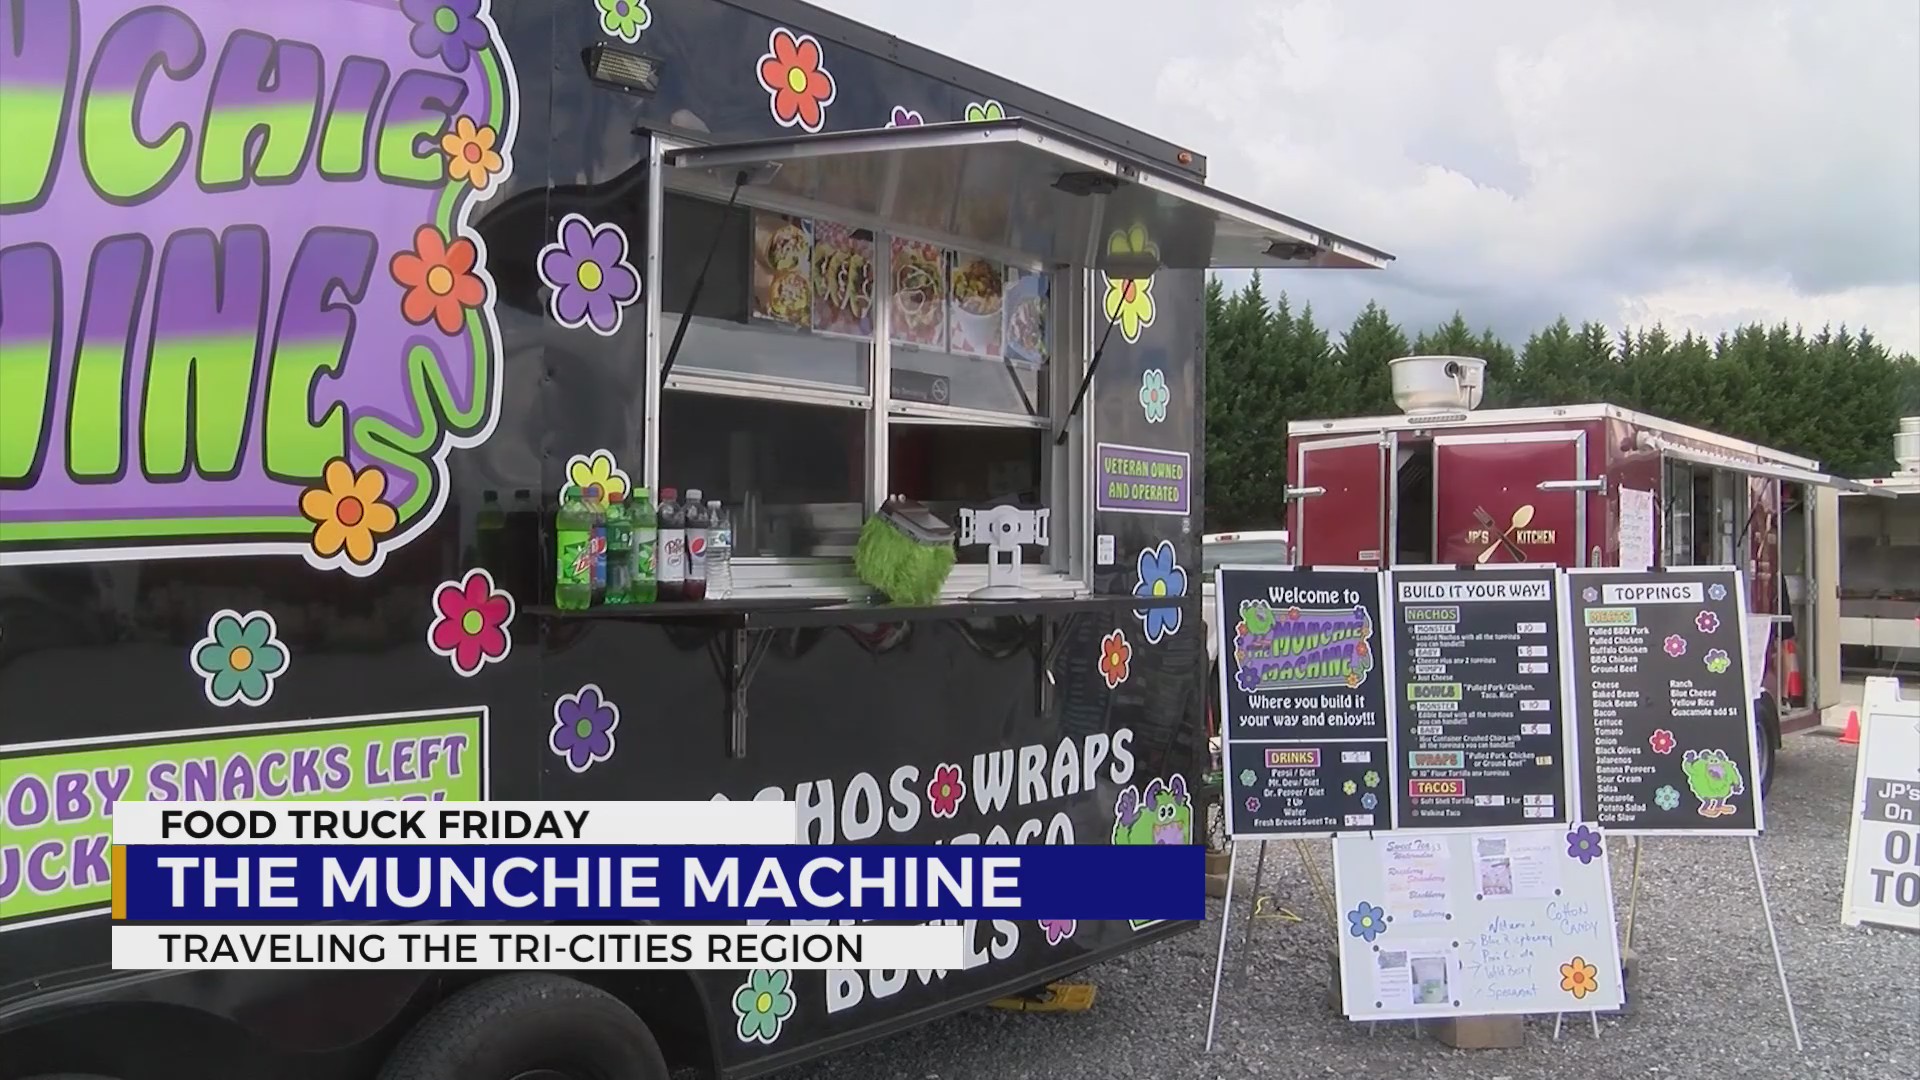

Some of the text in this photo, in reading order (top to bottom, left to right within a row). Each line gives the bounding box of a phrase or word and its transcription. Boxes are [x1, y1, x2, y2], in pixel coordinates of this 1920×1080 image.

[1104, 457, 1184, 480] VETERAN OWNED
[1108, 482, 1179, 502] AND OPERATED
[1465, 530, 1555, 544] JP'S KITCHEN
[1268, 587, 1360, 603] Welcome to
[1404, 584, 1546, 598] BUILD IT YOUR WAY!
[1615, 587, 1692, 601] TOPPINGS
[1408, 610, 1456, 619] NACHOS
[1272, 621, 1364, 657] MUNCHIE
[1590, 646, 1617, 654] Buffalo
[1261, 644, 1354, 681] MACHINE
[1591, 665, 1618, 673] Ground
[1414, 686, 1455, 698] BOWLS
[1670, 689, 1717, 697] Blue Cheese
[1249, 695, 1364, 708] Where you build it
[1697, 698, 1714, 706] Rice
[1593, 709, 1616, 717] Bacon
[1671, 708, 1712, 716] Guacamole
[1240, 712, 1375, 726] your way and enjoy!!!
[1271, 752, 1314, 763] DRINKS
[149, 746, 351, 801] SNACKS
[365, 735, 469, 785] LEFT
[971, 727, 1136, 816] WRAPS
[1624, 765, 1656, 773] Peppers
[1597, 775, 1642, 783] Sour Cream
[1417, 783, 1457, 792] TACOS
[1597, 794, 1634, 802] Pineapple
[1284, 808, 1306, 816] Water
[1598, 813, 1635, 821] Cole Slaw
[1885, 803, 1912, 821] On
[1302, 818, 1323, 826] Sweet
[1324, 817, 1337, 825] Tea
[1386, 840, 1430, 851] Sweet Tea
[1885, 830, 1920, 866] O
